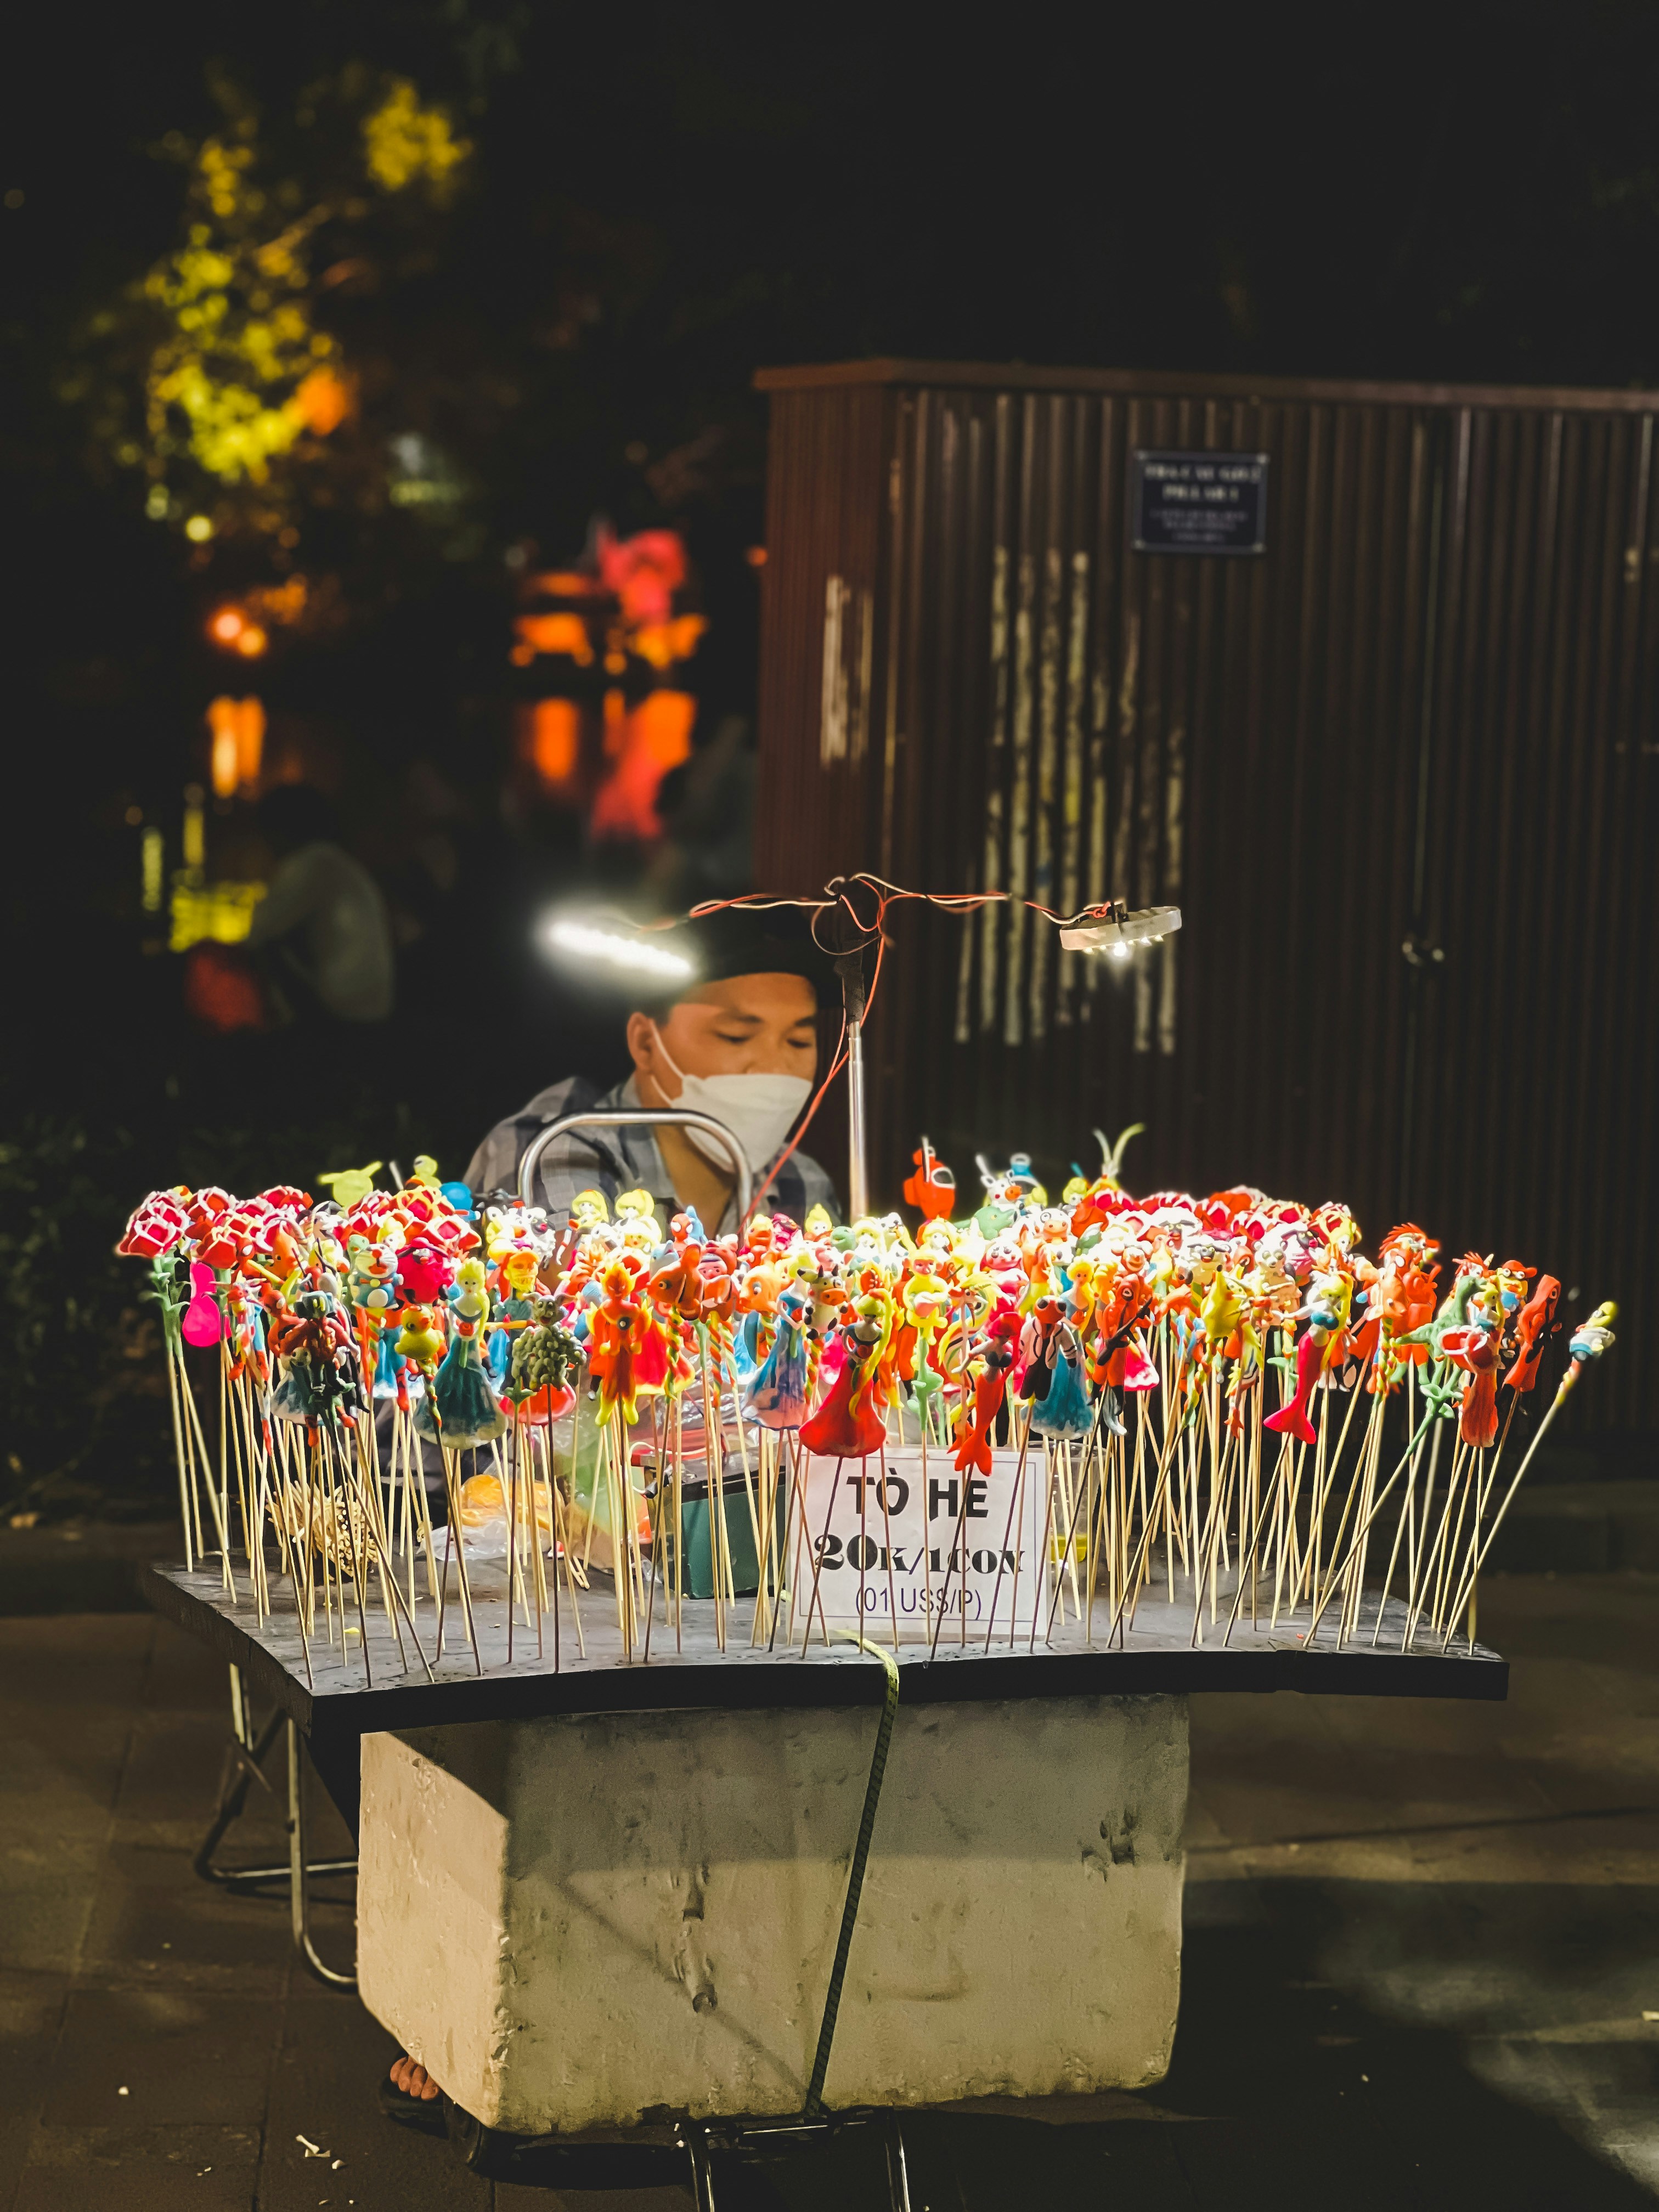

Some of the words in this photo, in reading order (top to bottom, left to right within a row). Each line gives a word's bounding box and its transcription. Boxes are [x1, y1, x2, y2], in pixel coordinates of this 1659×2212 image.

[847, 1468, 909, 1516] TÒ
[929, 1479, 989, 1522] HE
[856, 1587, 889, 1616] (01
